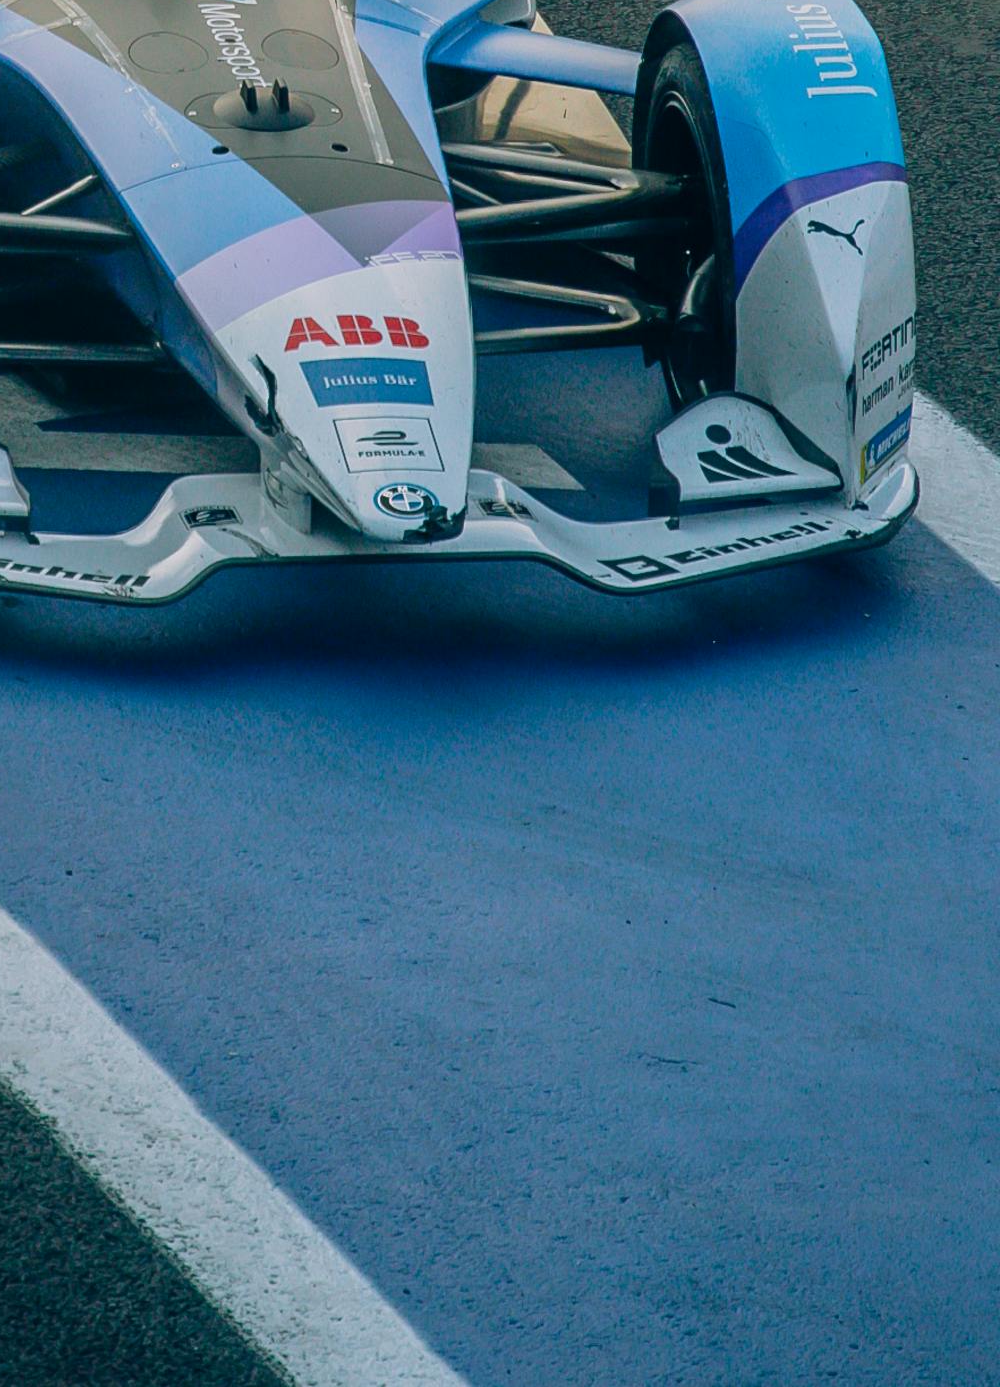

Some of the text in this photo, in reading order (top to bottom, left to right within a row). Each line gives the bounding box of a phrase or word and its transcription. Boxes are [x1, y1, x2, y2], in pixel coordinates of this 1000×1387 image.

[197, 3, 274, 88] Motorsport
[785, 3, 878, 99] Julius
[284, 314, 430, 352] ABB
[322, 373, 417, 389] Julius Bär
[663, 520, 830, 565] Einhell
